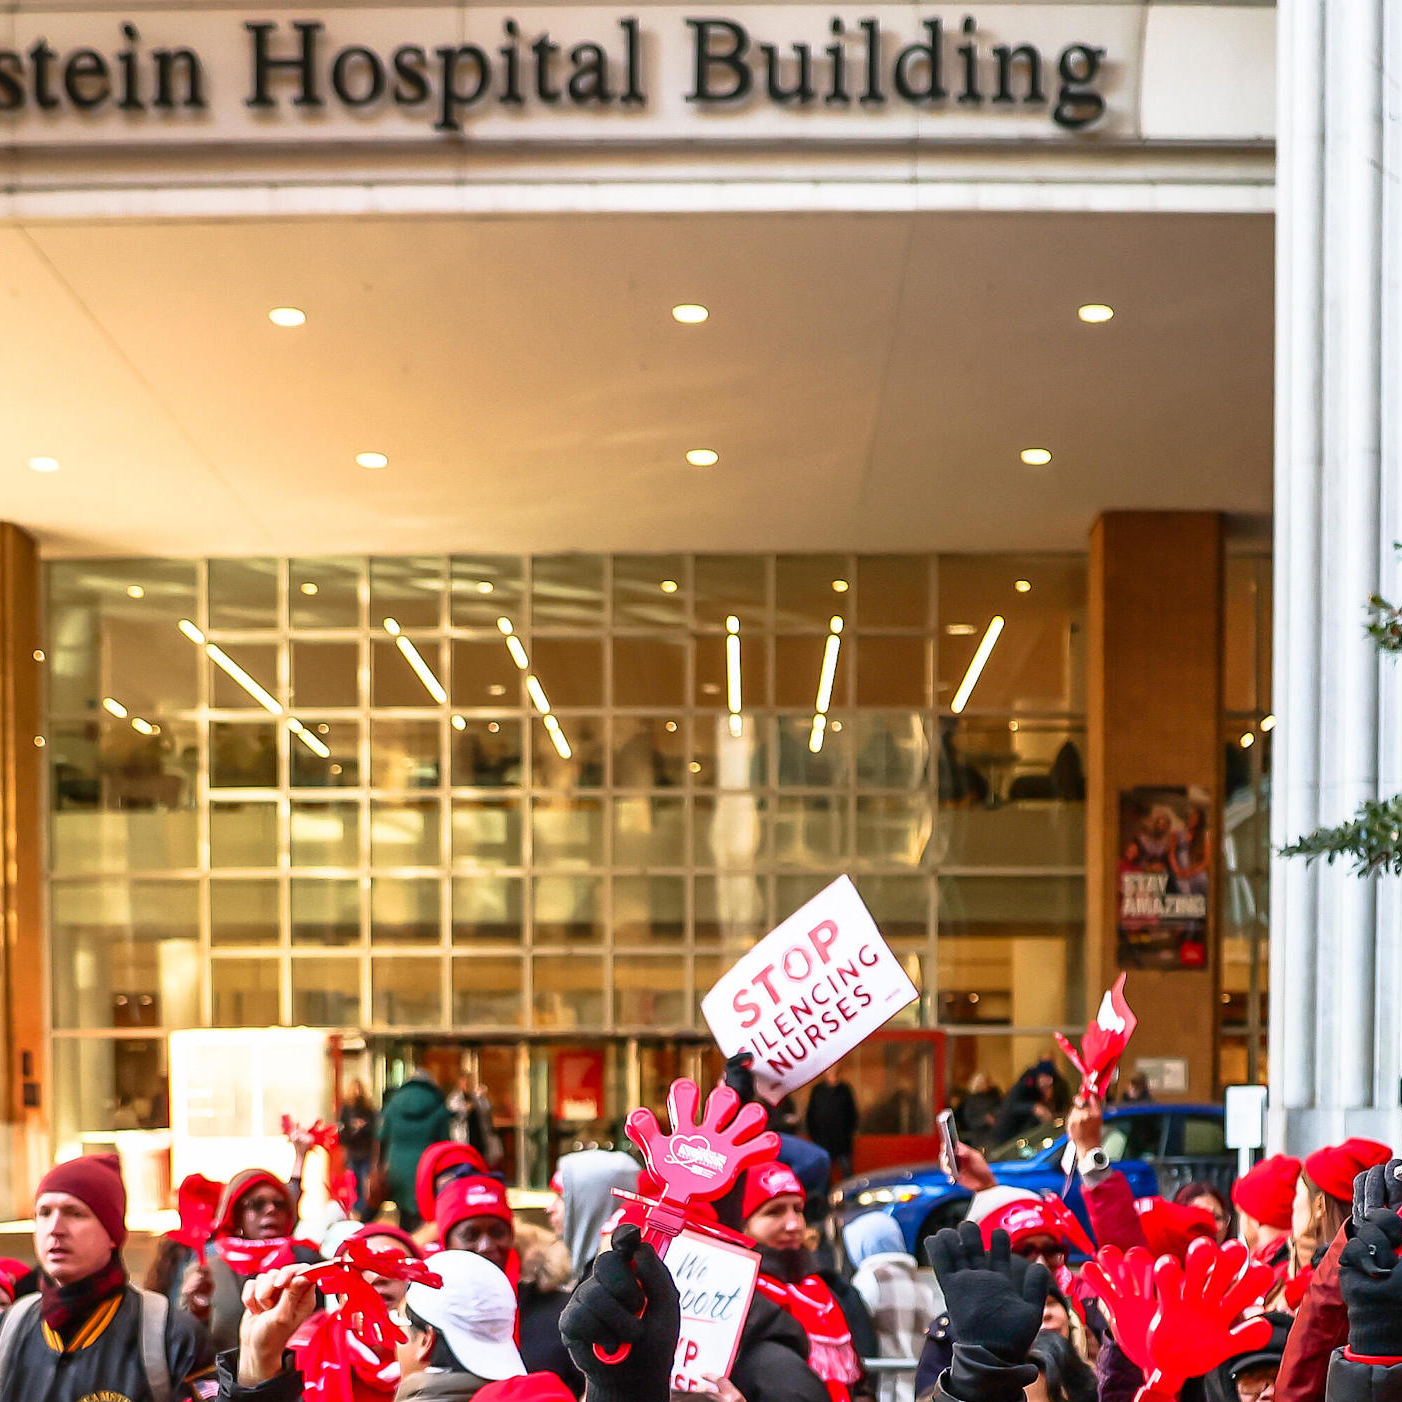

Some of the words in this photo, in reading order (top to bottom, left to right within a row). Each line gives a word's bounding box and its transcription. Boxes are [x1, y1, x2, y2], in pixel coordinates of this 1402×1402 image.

[244, 18, 647, 130] Hospital
[684, 14, 1107, 128] Building
[732, 918, 839, 1029] STOP
[766, 984, 873, 1077] NURSES
